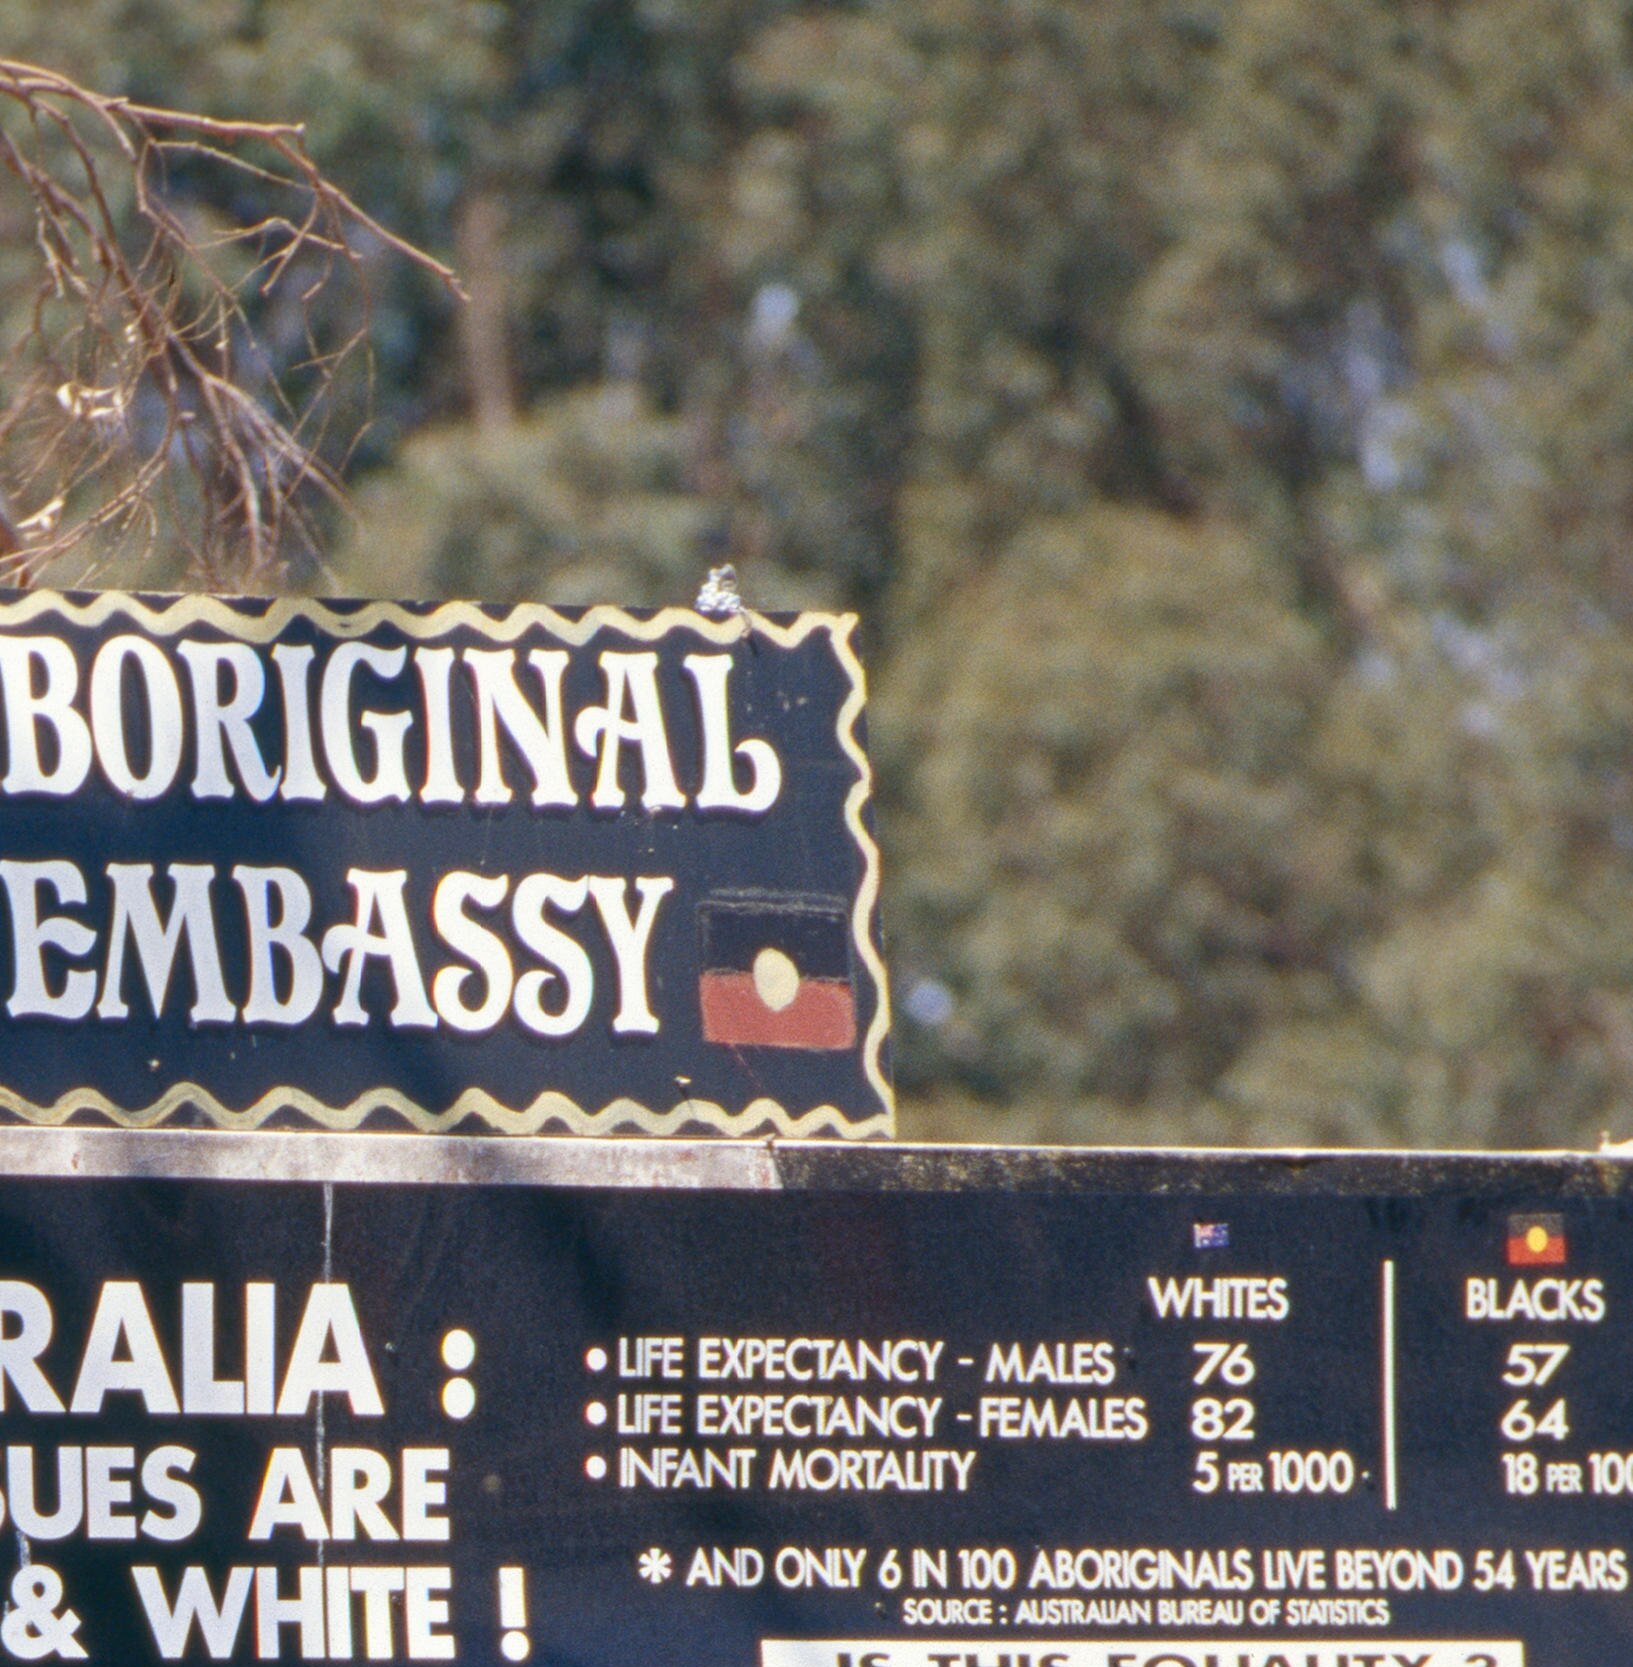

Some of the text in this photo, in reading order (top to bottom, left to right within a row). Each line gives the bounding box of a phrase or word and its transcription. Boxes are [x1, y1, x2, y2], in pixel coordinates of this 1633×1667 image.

[1146, 1276, 1290, 1321] WHITES
[1466, 1278, 1606, 1323] BLACKS
[618, 1336, 684, 1379] LIFE
[697, 1337, 945, 1383] EXPECTANCY
[984, 1341, 1117, 1386] MALES
[1192, 1342, 1256, 1387] 76
[1502, 1343, 1571, 1387] 57
[617, 1393, 683, 1435] LIFE
[696, 1394, 943, 1439] EXPECTANCY
[979, 1396, 1149, 1441] FEMALES
[1190, 1397, 1256, 1442] 82
[1500, 1398, 1570, 1442] 64
[619, 1446, 977, 1492] INFANT MORTALITY
[1192, 1449, 1355, 1494] 5 PER 1000
[1501, 1451, 1540, 1496] 18
[1545, 1462, 1584, 1494] PER
[248, 1446, 450, 1541] ARE
[685, 1546, 1629, 1592] AND ONLY 6 IN 100 ABORIGINALS LIVE BEYOND 54 YEARS
[0, 1562, 89, 1660] &
[131, 1566, 456, 1660] WHITE
[902, 1598, 994, 1625] SOURCE
[1014, 1598, 1152, 1625] AUSTRALIAN
[1157, 1599, 1244, 1626] BUREAU
[1248, 1599, 1282, 1626] OF
[1285, 1599, 1392, 1627] STATISTICS
